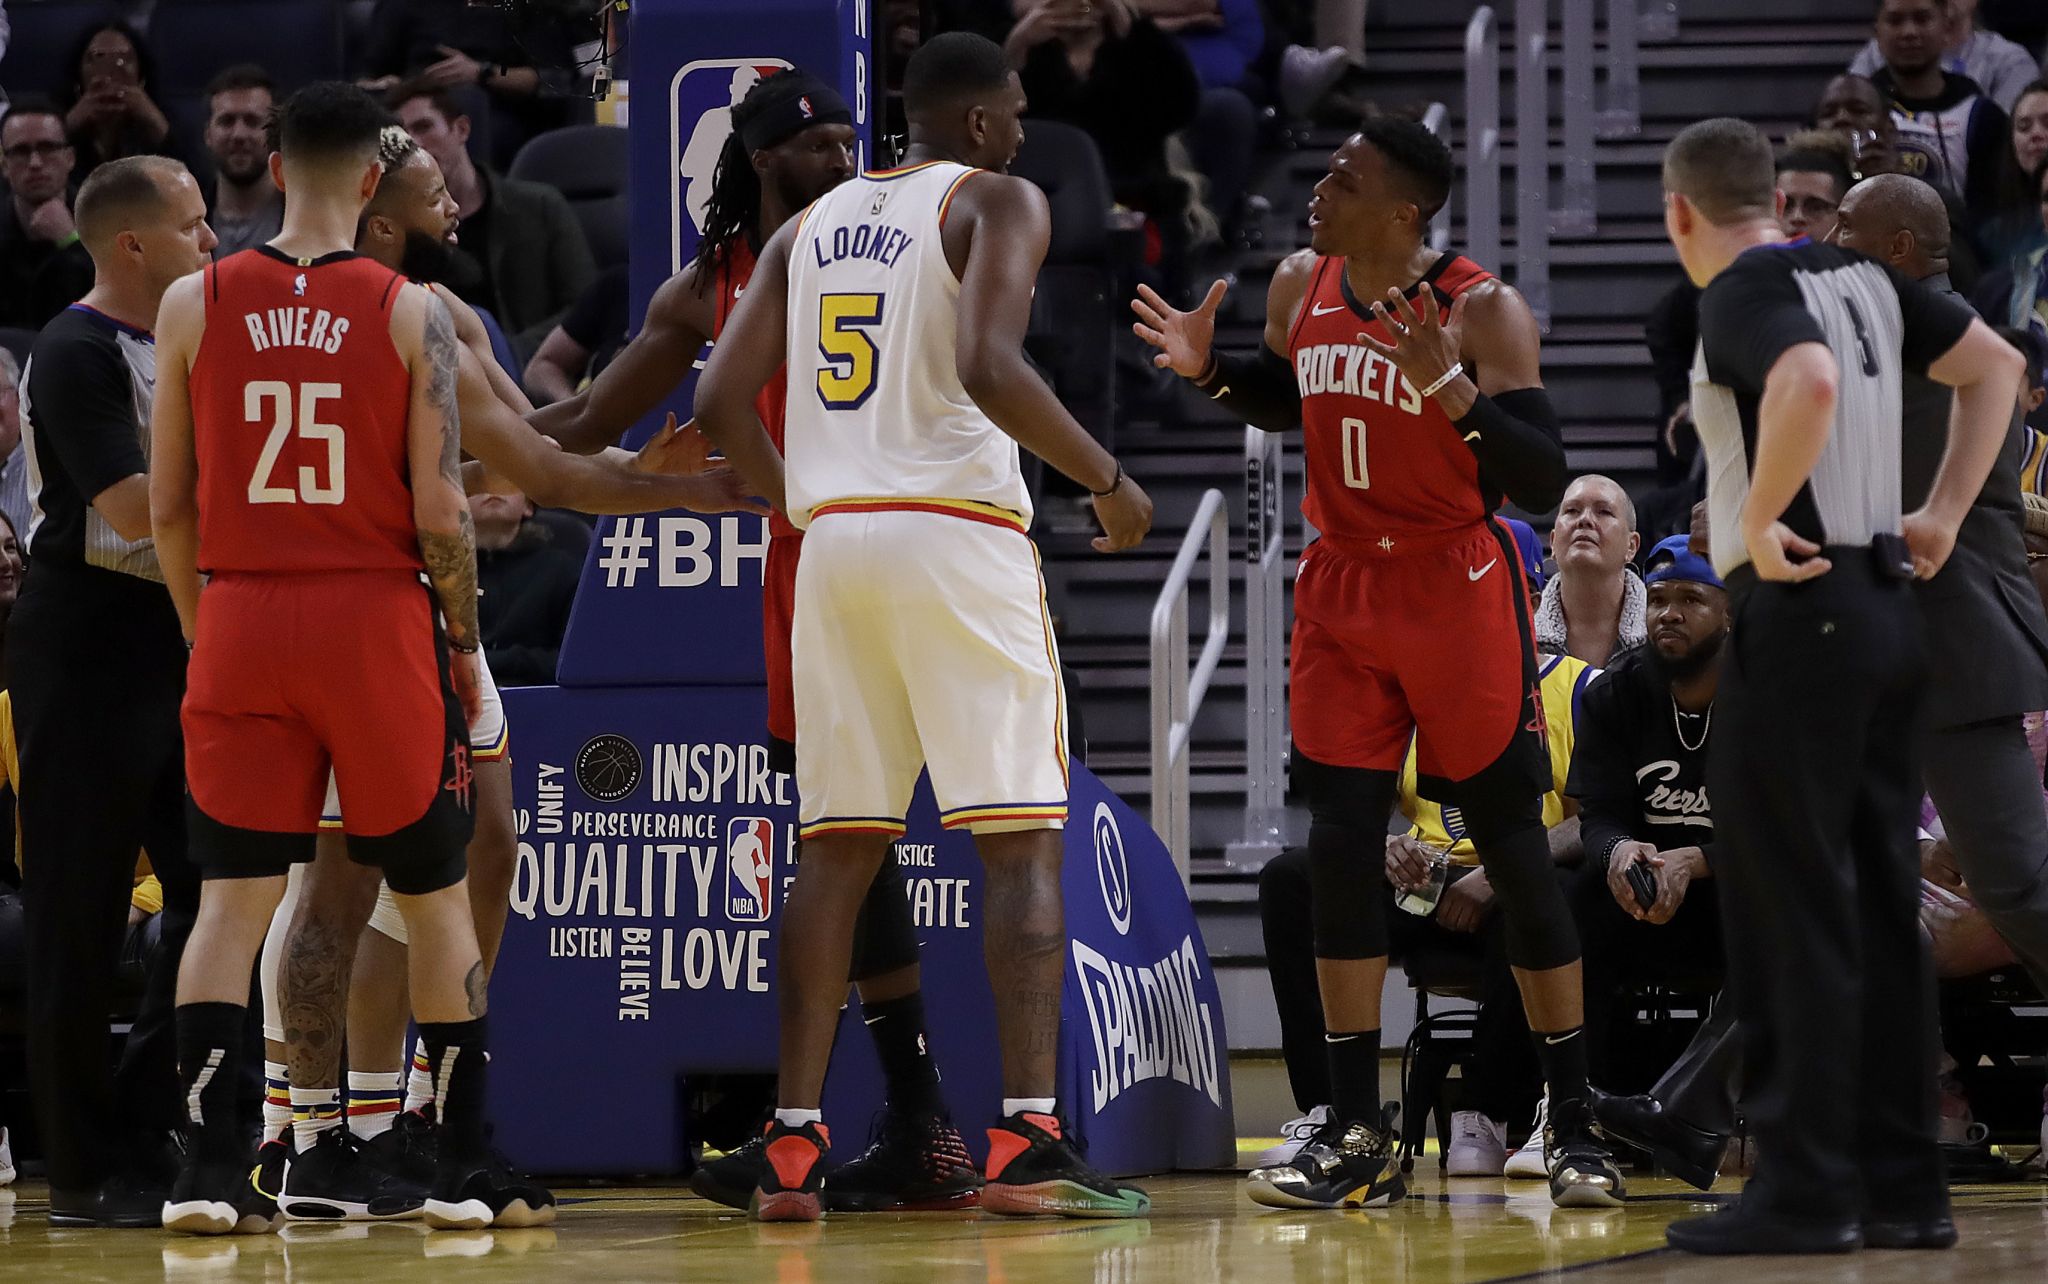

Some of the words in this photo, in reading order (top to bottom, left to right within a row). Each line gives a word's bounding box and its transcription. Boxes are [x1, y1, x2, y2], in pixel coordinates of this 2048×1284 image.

[814, 224, 913, 269] LOONEY
[244, 306, 350, 354] RIVERS
[816, 293, 885, 411] 5
[1297, 344, 1422, 416] ROCKETS
[244, 381, 345, 505] 25
[1342, 417, 1370, 490] 0
[599, 516, 772, 588] #BH
[537, 763, 564, 834] UNIFY
[652, 743, 792, 806] INSPIRE
[572, 811, 718, 839] PERSEVERANCE
[509, 842, 718, 920] QUALITY
[732, 897, 754, 915] NBA
[550, 927, 612, 958] LISTEN
[619, 927, 651, 1021] BELIEVE
[661, 927, 770, 992] LOVE
[1072, 934, 1220, 1114] SPALDING
